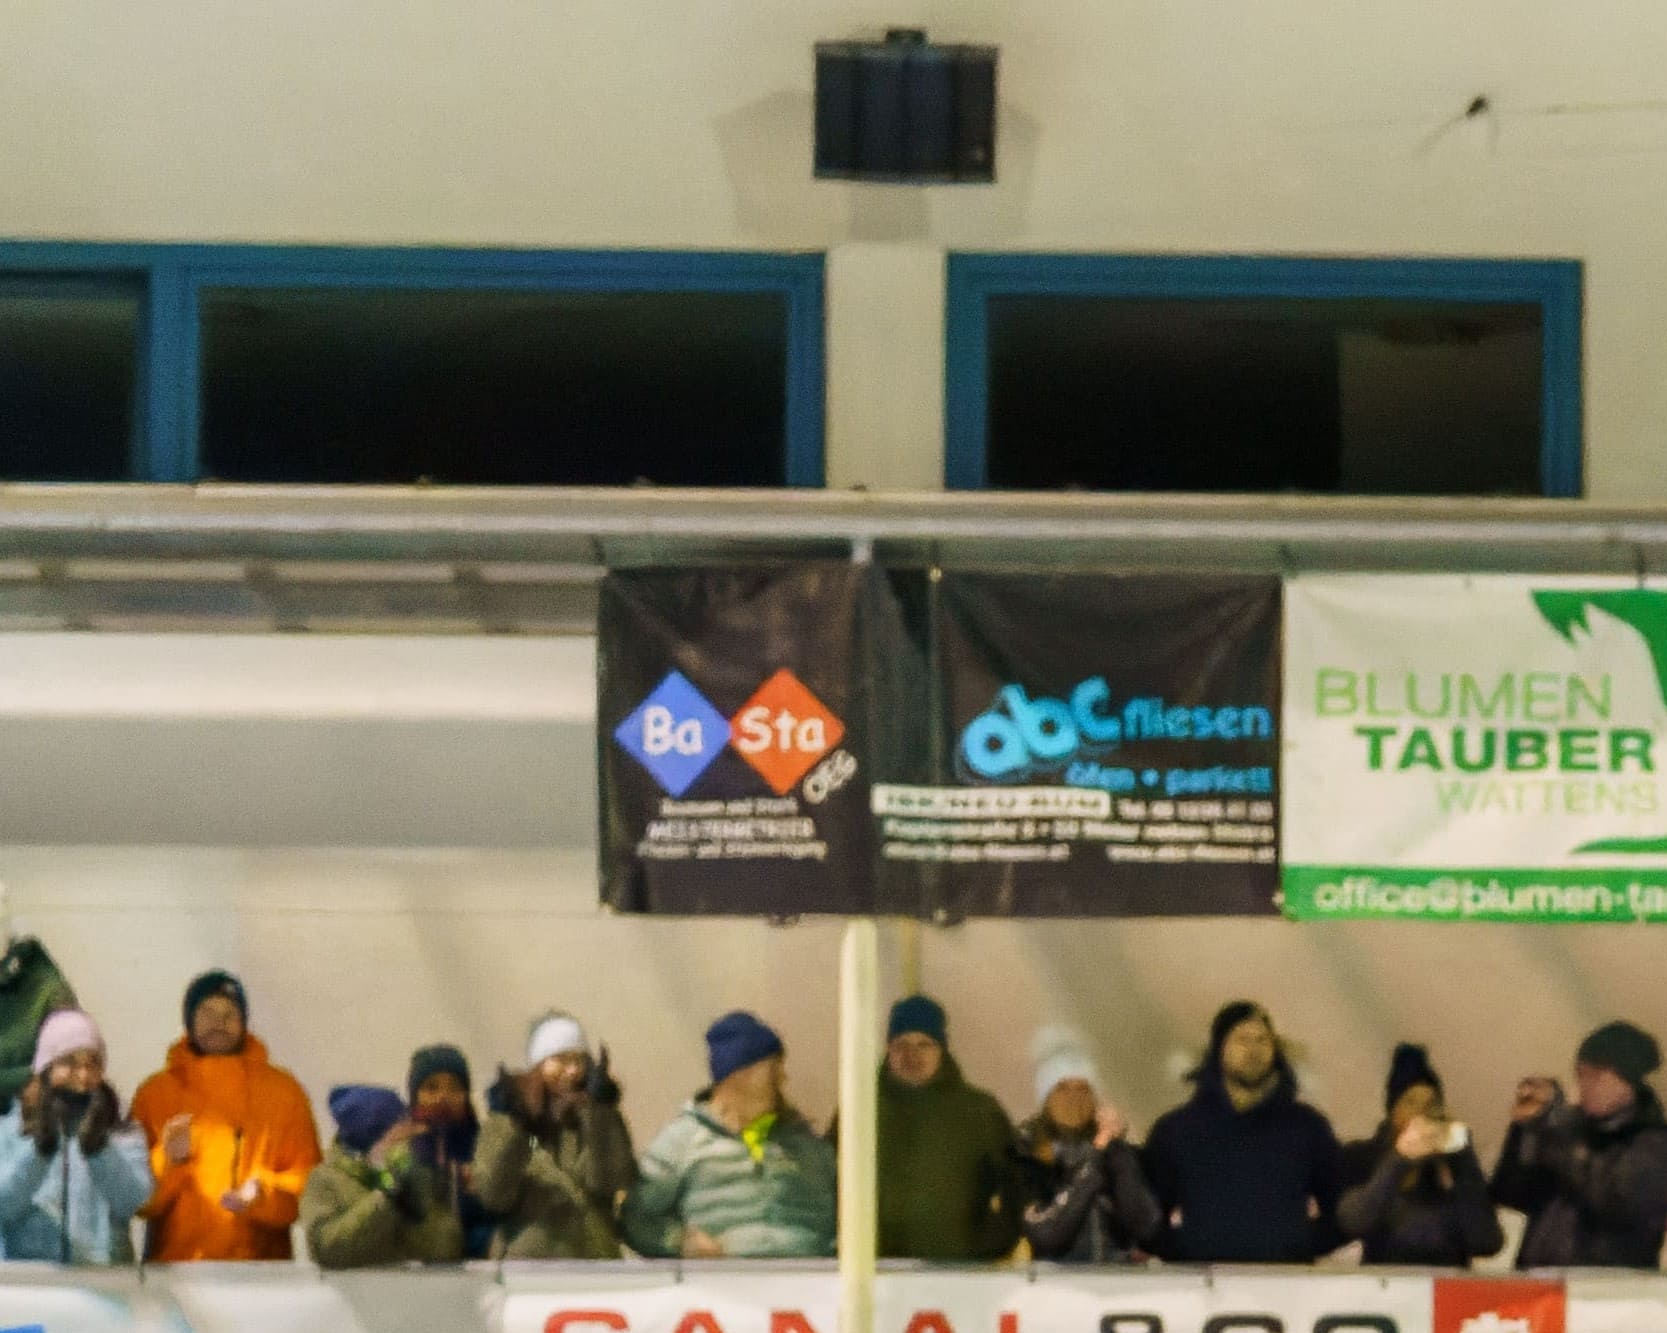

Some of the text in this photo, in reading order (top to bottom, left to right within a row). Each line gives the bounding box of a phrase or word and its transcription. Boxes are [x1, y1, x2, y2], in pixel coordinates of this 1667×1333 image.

[1315, 667, 1612, 722] BLUMEN
[643, 705, 827, 756] Ba Sta
[1355, 727, 1656, 773] TAUBER
[1436, 779, 1659, 816] WATTENS
